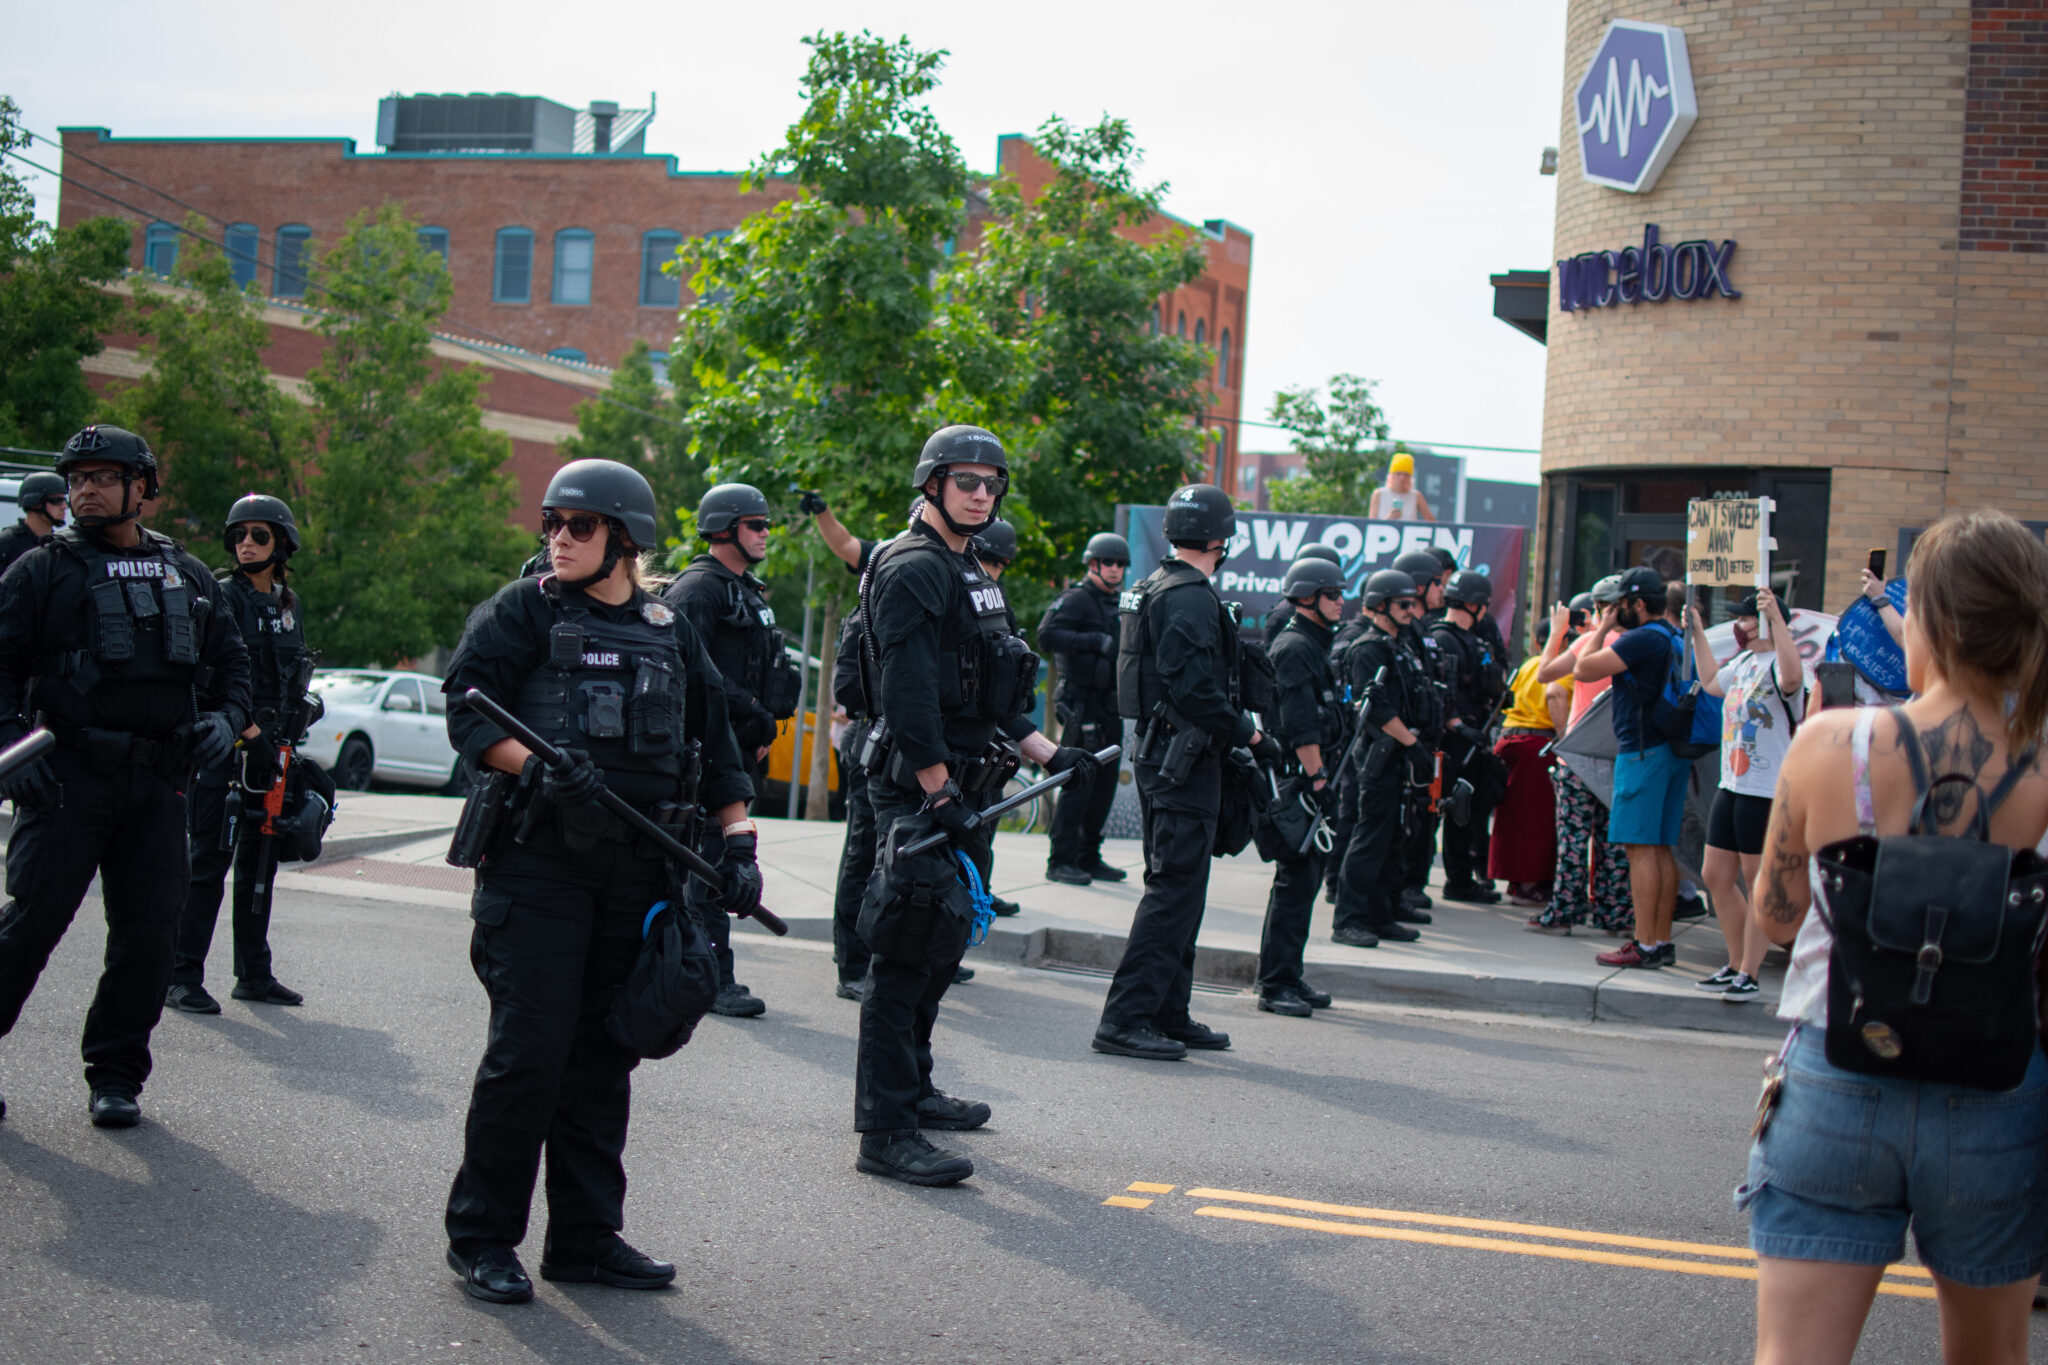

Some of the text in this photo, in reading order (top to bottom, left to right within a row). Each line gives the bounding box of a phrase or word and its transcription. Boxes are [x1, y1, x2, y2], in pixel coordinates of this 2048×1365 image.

[1721, 502, 1760, 530] SWEEP
[1320, 521, 1474, 570] OPEN
[1708, 528, 1736, 553] AWAY
[106, 561, 164, 577] POLICE
[1716, 557, 1728, 581] DO
[1730, 560, 1754, 573] BETTER
